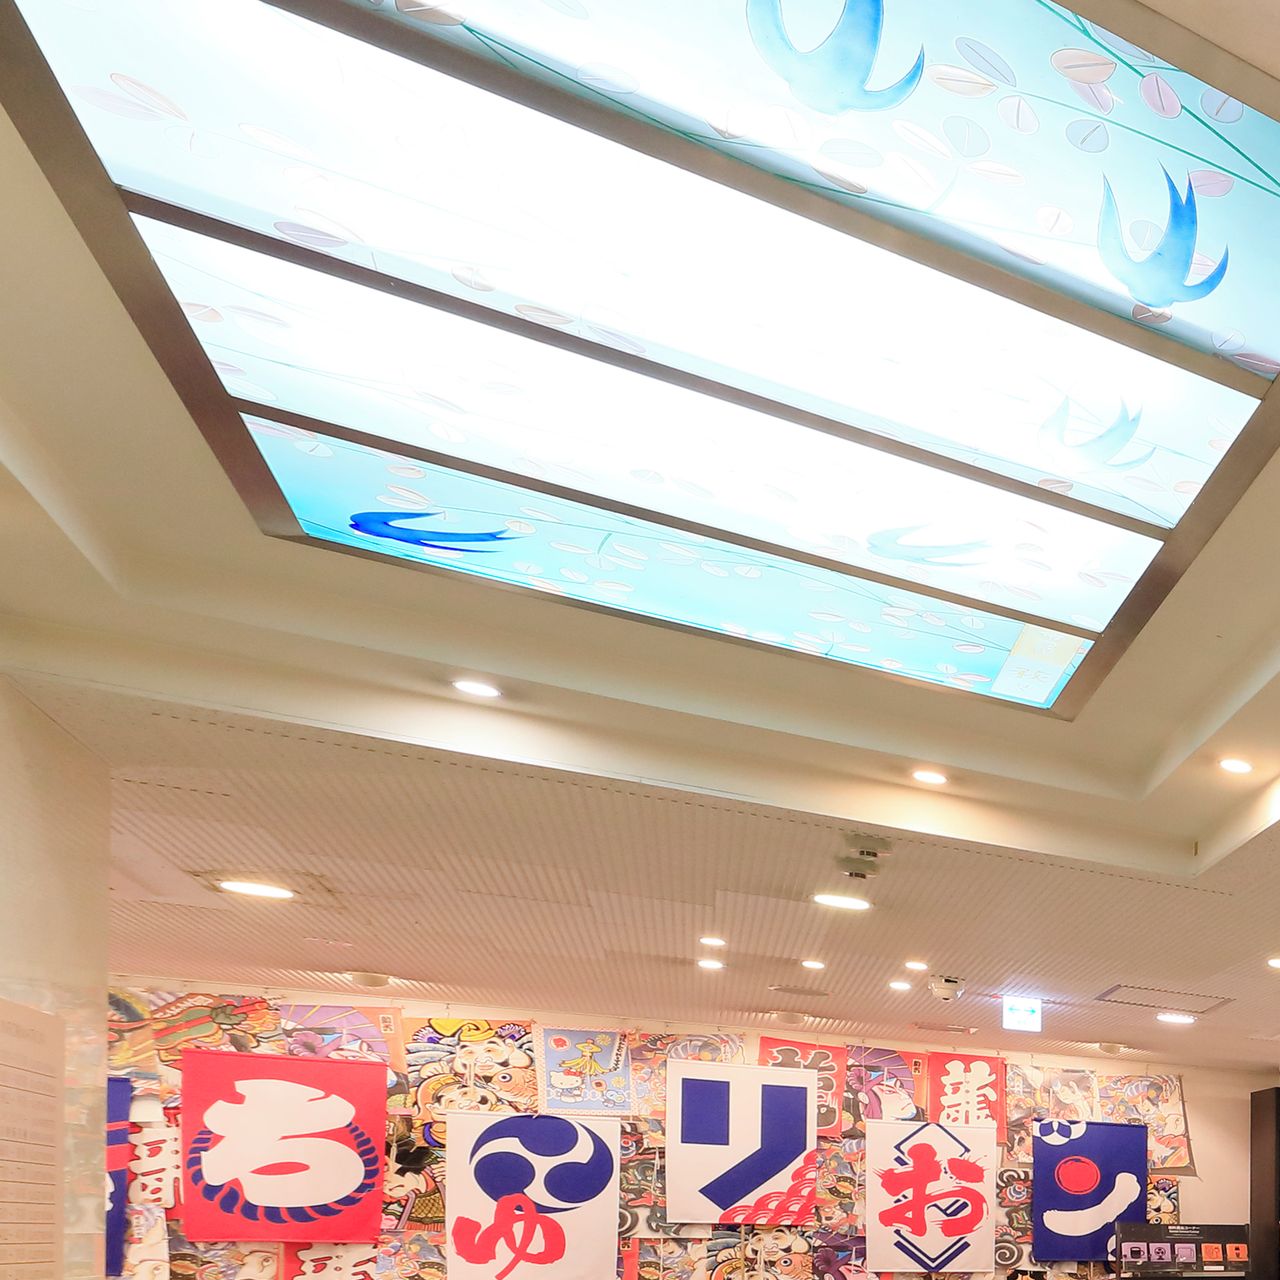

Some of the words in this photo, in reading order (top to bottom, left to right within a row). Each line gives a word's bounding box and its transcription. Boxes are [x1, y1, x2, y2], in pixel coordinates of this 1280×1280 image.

[681, 1077, 807, 1210] リ
[873, 1142, 990, 1238] お
[452, 1193, 567, 1280] ゆ
